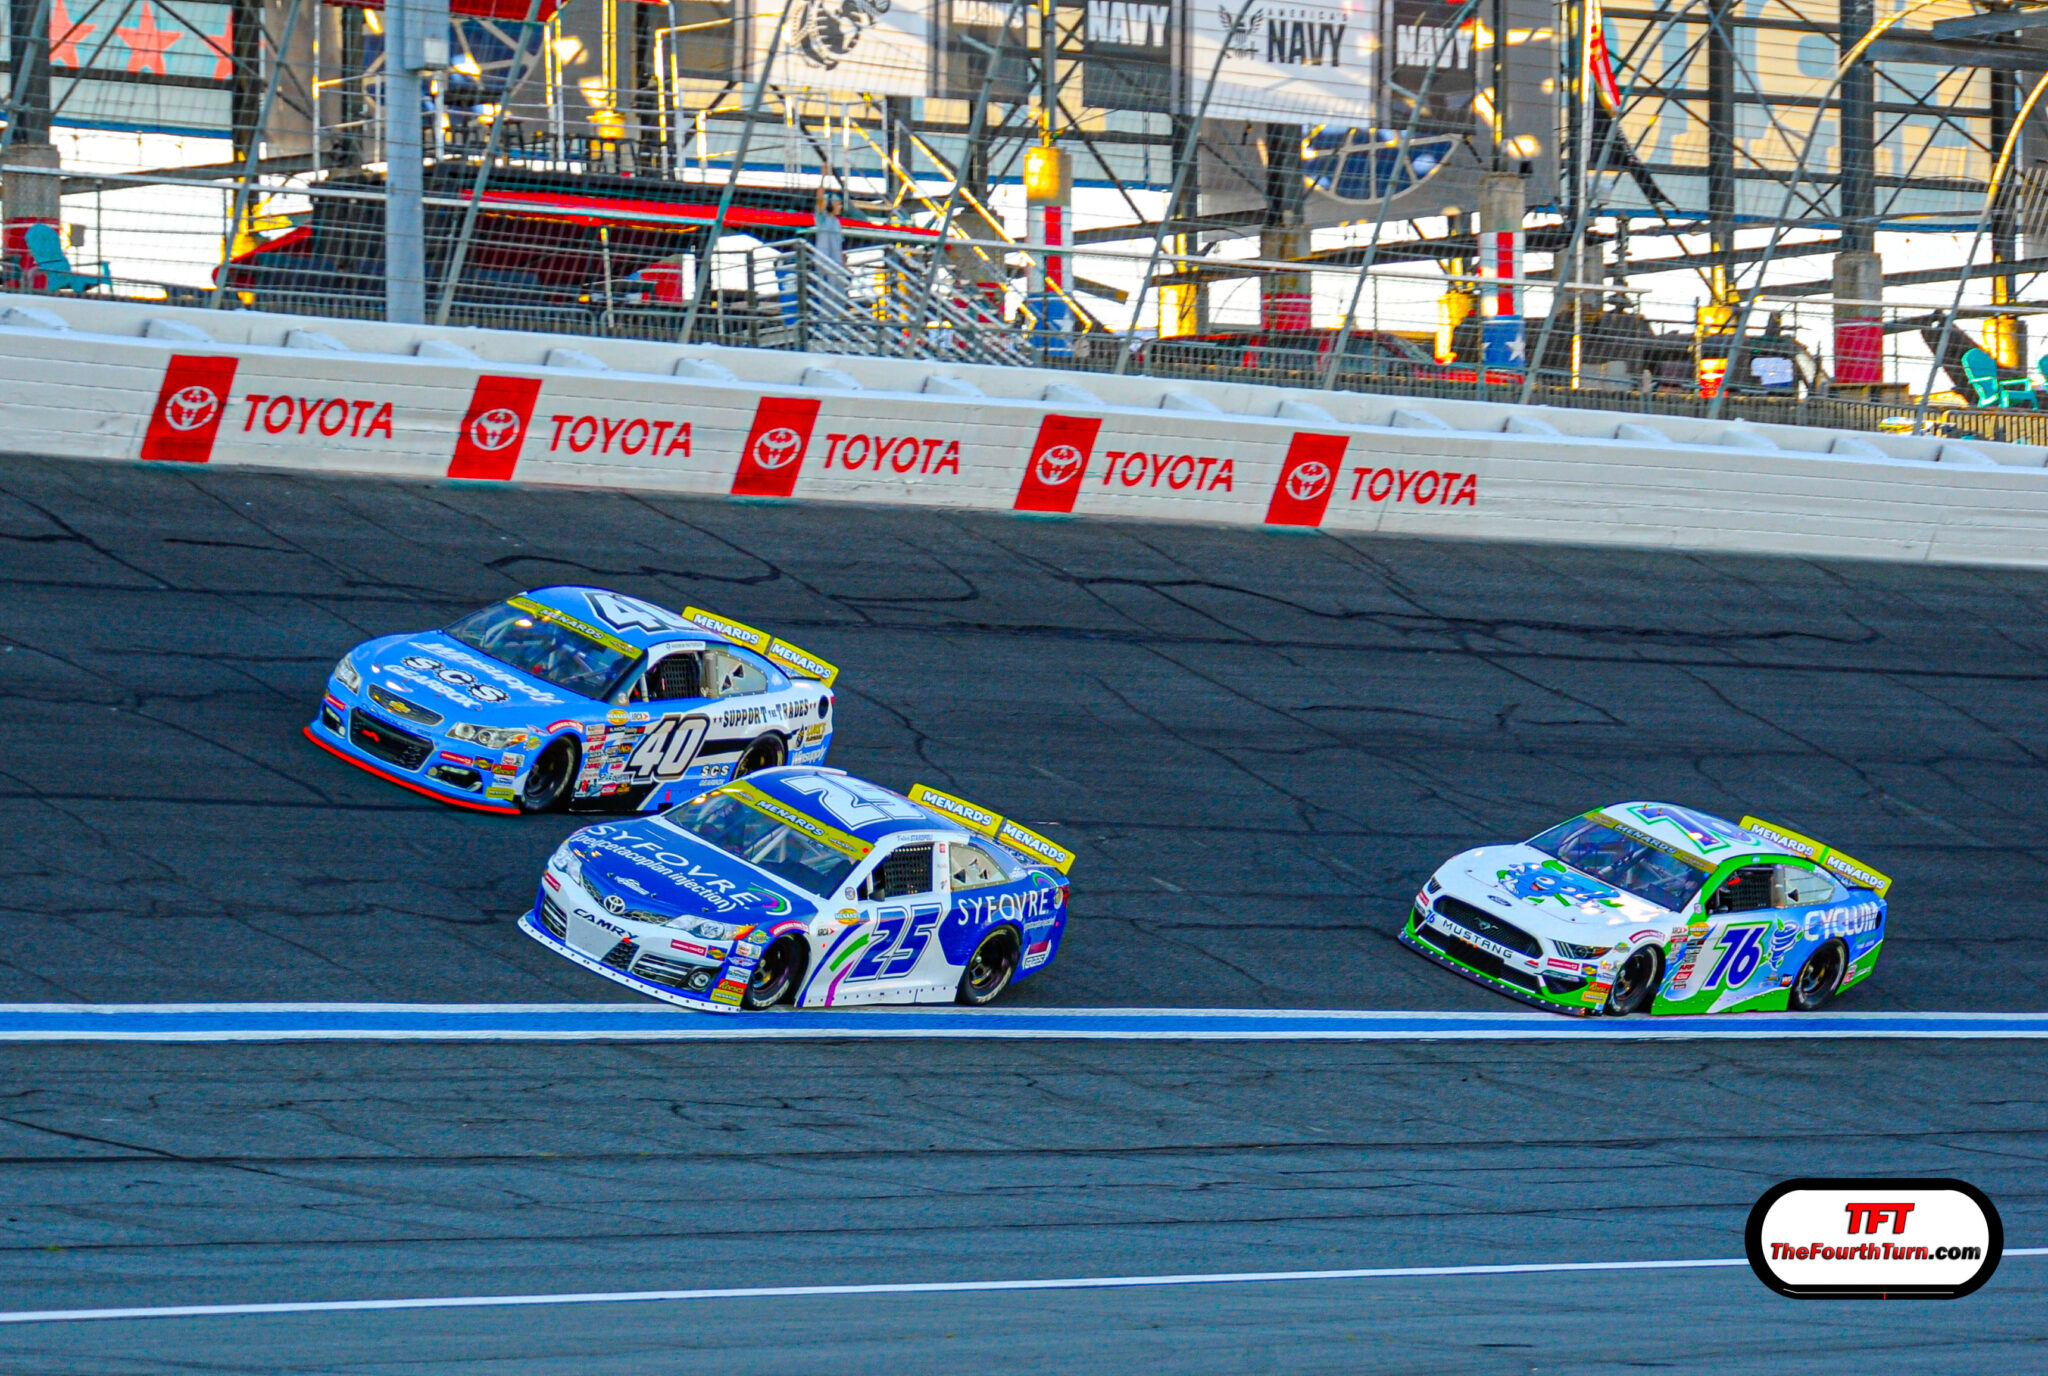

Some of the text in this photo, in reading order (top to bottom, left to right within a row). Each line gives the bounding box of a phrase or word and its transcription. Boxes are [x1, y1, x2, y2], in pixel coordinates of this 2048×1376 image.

[1087, 0, 1170, 46] NAVY
[1268, 9, 1348, 21] AMERICA'S
[1268, 20, 1345, 67] NAVY
[1396, 24, 1474, 69] NAVY
[244, 395, 394, 439] TOYOTA
[551, 414, 692, 457] TOYOTA
[824, 433, 961, 475] TOYOTA
[1102, 451, 1234, 492] TOYOTA
[1351, 466, 1477, 506] TOYOTA
[540, 608, 604, 640] MENARDS
[693, 613, 761, 645] MENARDS
[403, 656, 510, 703] SCS
[771, 643, 832, 680] MENARDS
[382, 664, 482, 711] GEARBOX
[723, 706, 768, 728] SUPPORT
[775, 698, 809, 720] TRADES
[625, 714, 709, 782] 40
[757, 800, 825, 837] MENARDS
[923, 791, 993, 826] MENARDS
[1002, 823, 1067, 863] MENARDS
[1614, 824, 1677, 854] MENARDS
[1751, 824, 1814, 857] MENARDS
[570, 832, 670, 880] (pegcetacoplan
[667, 872, 737, 912] injection)
[587, 825, 761, 906] SYFOVRE
[1826, 856, 1886, 889] MENARDS
[573, 908, 639, 940] CAMRY
[957, 888, 1050, 925] SYFOVRE
[1425, 910, 1436, 924] 76
[1804, 901, 1879, 942] CYCLUM
[843, 903, 943, 983] 25
[1443, 919, 1514, 959] MUSTANG
[1703, 925, 1766, 988] 76
